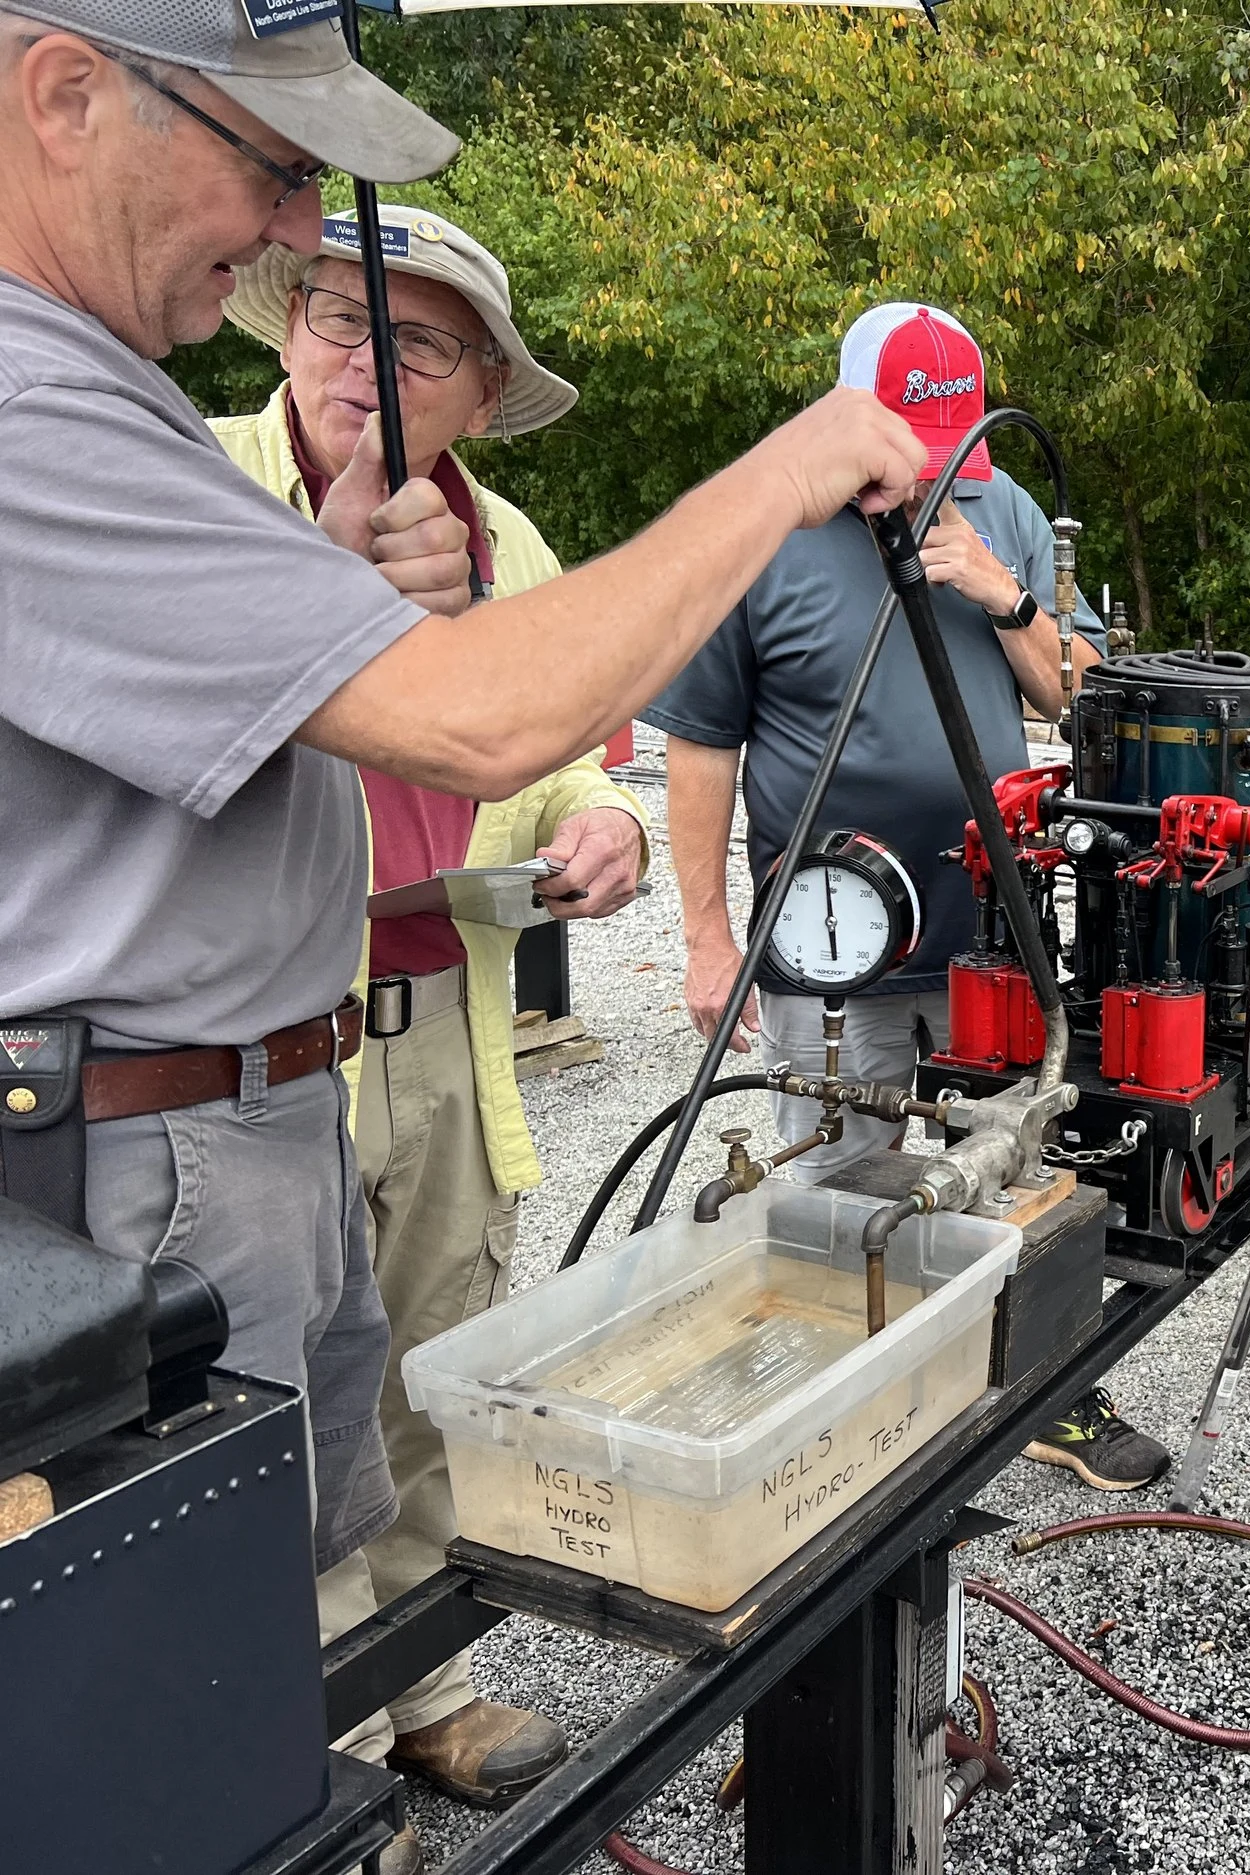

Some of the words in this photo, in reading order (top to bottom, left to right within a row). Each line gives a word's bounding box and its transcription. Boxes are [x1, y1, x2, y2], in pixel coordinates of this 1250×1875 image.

[254, 15, 273, 27] North
[272, 9, 297, 21] Georgia
[296, 5, 310, 16] Live
[334, 224, 357, 236] Wes
[339, 237, 362, 248] Georgi
[381, 242, 407, 252] teamers
[829, 874, 842, 883] 150
[796, 883, 809, 893] 100
[859, 889, 873, 899] 200
[782, 913, 792, 922] 50
[869, 922, 883, 931] 250
[796, 945, 802, 954] 0
[856, 951, 870, 959] 300
[1194, 1113, 1202, 1136] F
[762, 1428, 832, 1504] NGLS
[535, 1462, 614, 1505] NGLS
[545, 1496, 611, 1533] HYDRO
[549, 1526, 611, 1559] TEST
